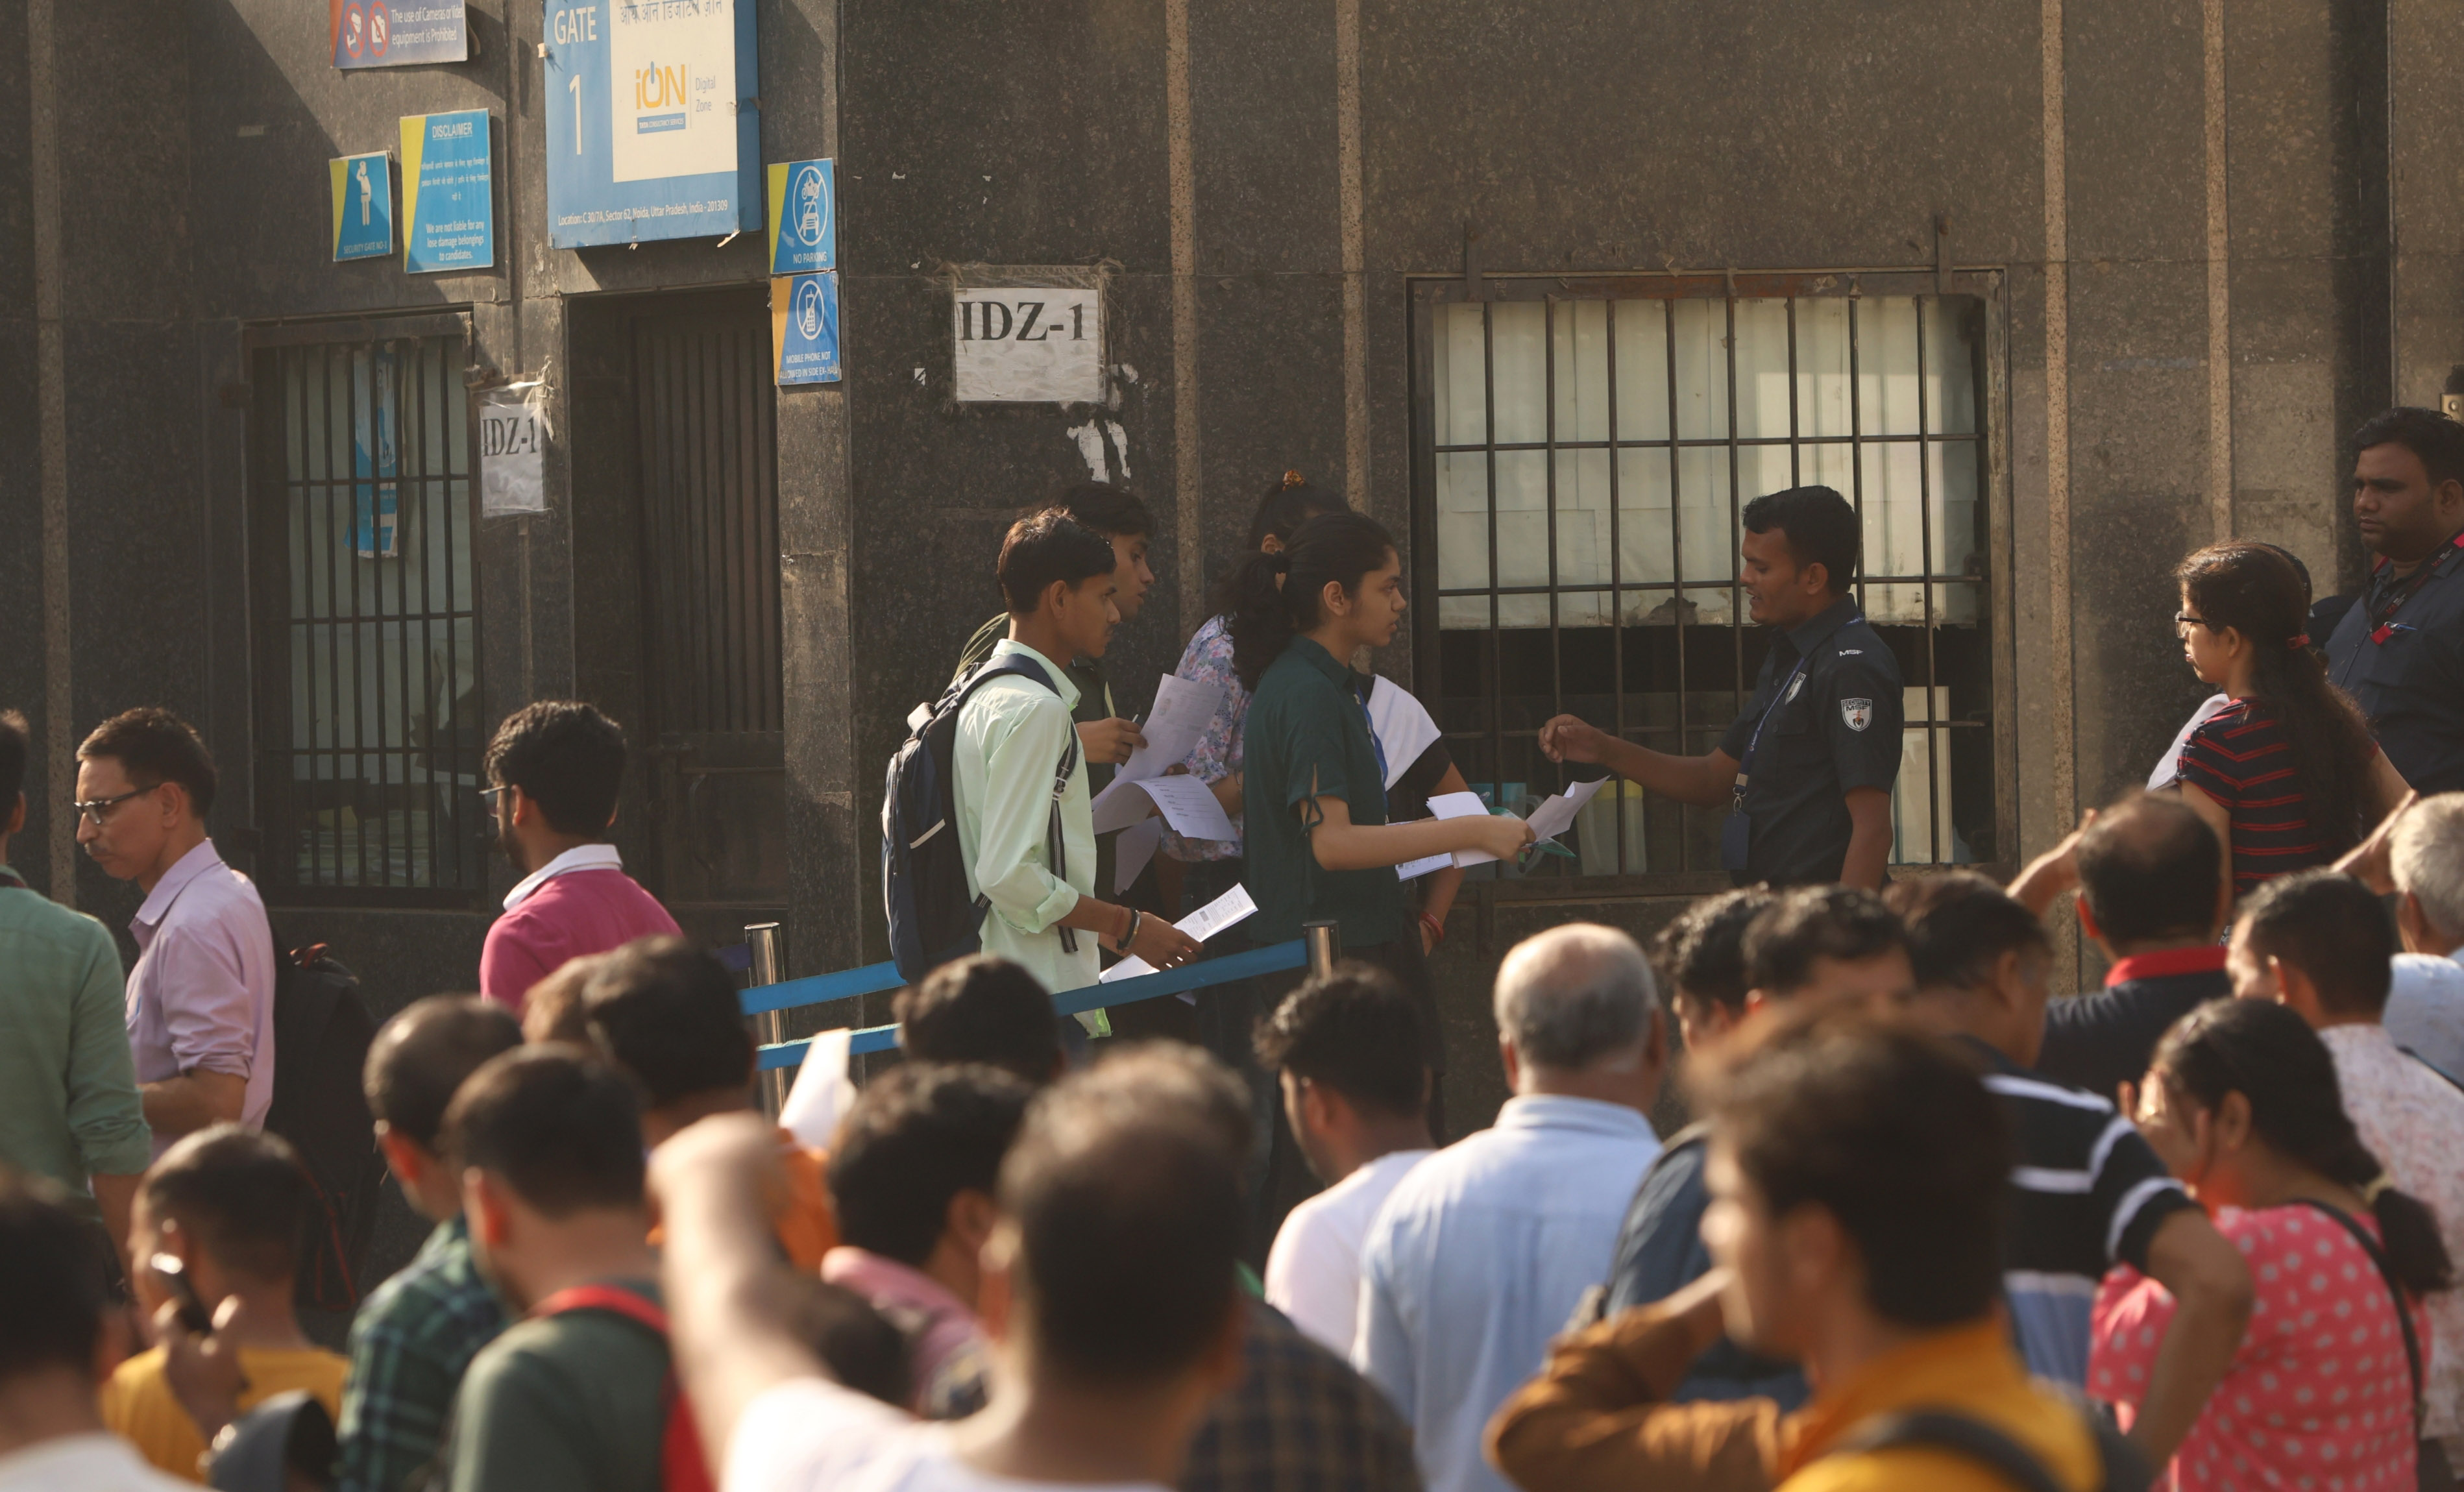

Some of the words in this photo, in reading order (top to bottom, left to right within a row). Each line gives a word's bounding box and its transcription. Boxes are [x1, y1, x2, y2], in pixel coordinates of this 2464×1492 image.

[391, 9, 402, 23] The
[404, 11, 414, 22] use
[415, 6, 422, 21] of
[422, 6, 445, 21] Cameras
[554, 6, 597, 45] GATE
[392, 30, 425, 49] equipment
[426, 29, 430, 43] is
[431, 26, 457, 42] Prohibited
[636, 61, 686, 110] iON
[695, 75, 716, 93] Digital
[696, 99, 712, 112] Zone
[569, 74, 582, 155] 1
[432, 122, 473, 138] DISCLAIMER
[558, 213, 582, 226] Location:
[583, 212, 587, 223] C
[605, 210, 623, 221] Sector
[624, 208, 632, 222] 62,
[633, 206, 650, 219] Noida,
[651, 206, 665, 217] Uttar
[665, 202, 689, 215] Pradesh,
[689, 201, 703, 213] India
[707, 199, 728, 212] 201309
[426, 223, 434, 234] We
[444, 223, 453, 232] not
[453, 220, 467, 232] liable
[476, 221, 485, 232] any
[343, 243, 363, 254] SECURITY
[364, 241, 375, 252] GATE
[376, 241, 387, 250] NO-1
[427, 237, 437, 248] lose
[438, 237, 457, 249] damage
[458, 234, 484, 247] belongings
[439, 252, 445, 261] to
[445, 249, 473, 260] candidates.
[793, 253, 802, 264] NO
[803, 251, 827, 263] PARKING
[957, 301, 1088, 341] IDZ-1
[786, 354, 804, 364] MOBILE
[805, 352, 821, 362] PHONE
[821, 351, 831, 361] NOT
[779, 369, 802, 380] ALLOWED
[803, 368, 808, 377] IN
[809, 367, 819, 376] SIDE
[482, 416, 537, 457] IDZ-1
